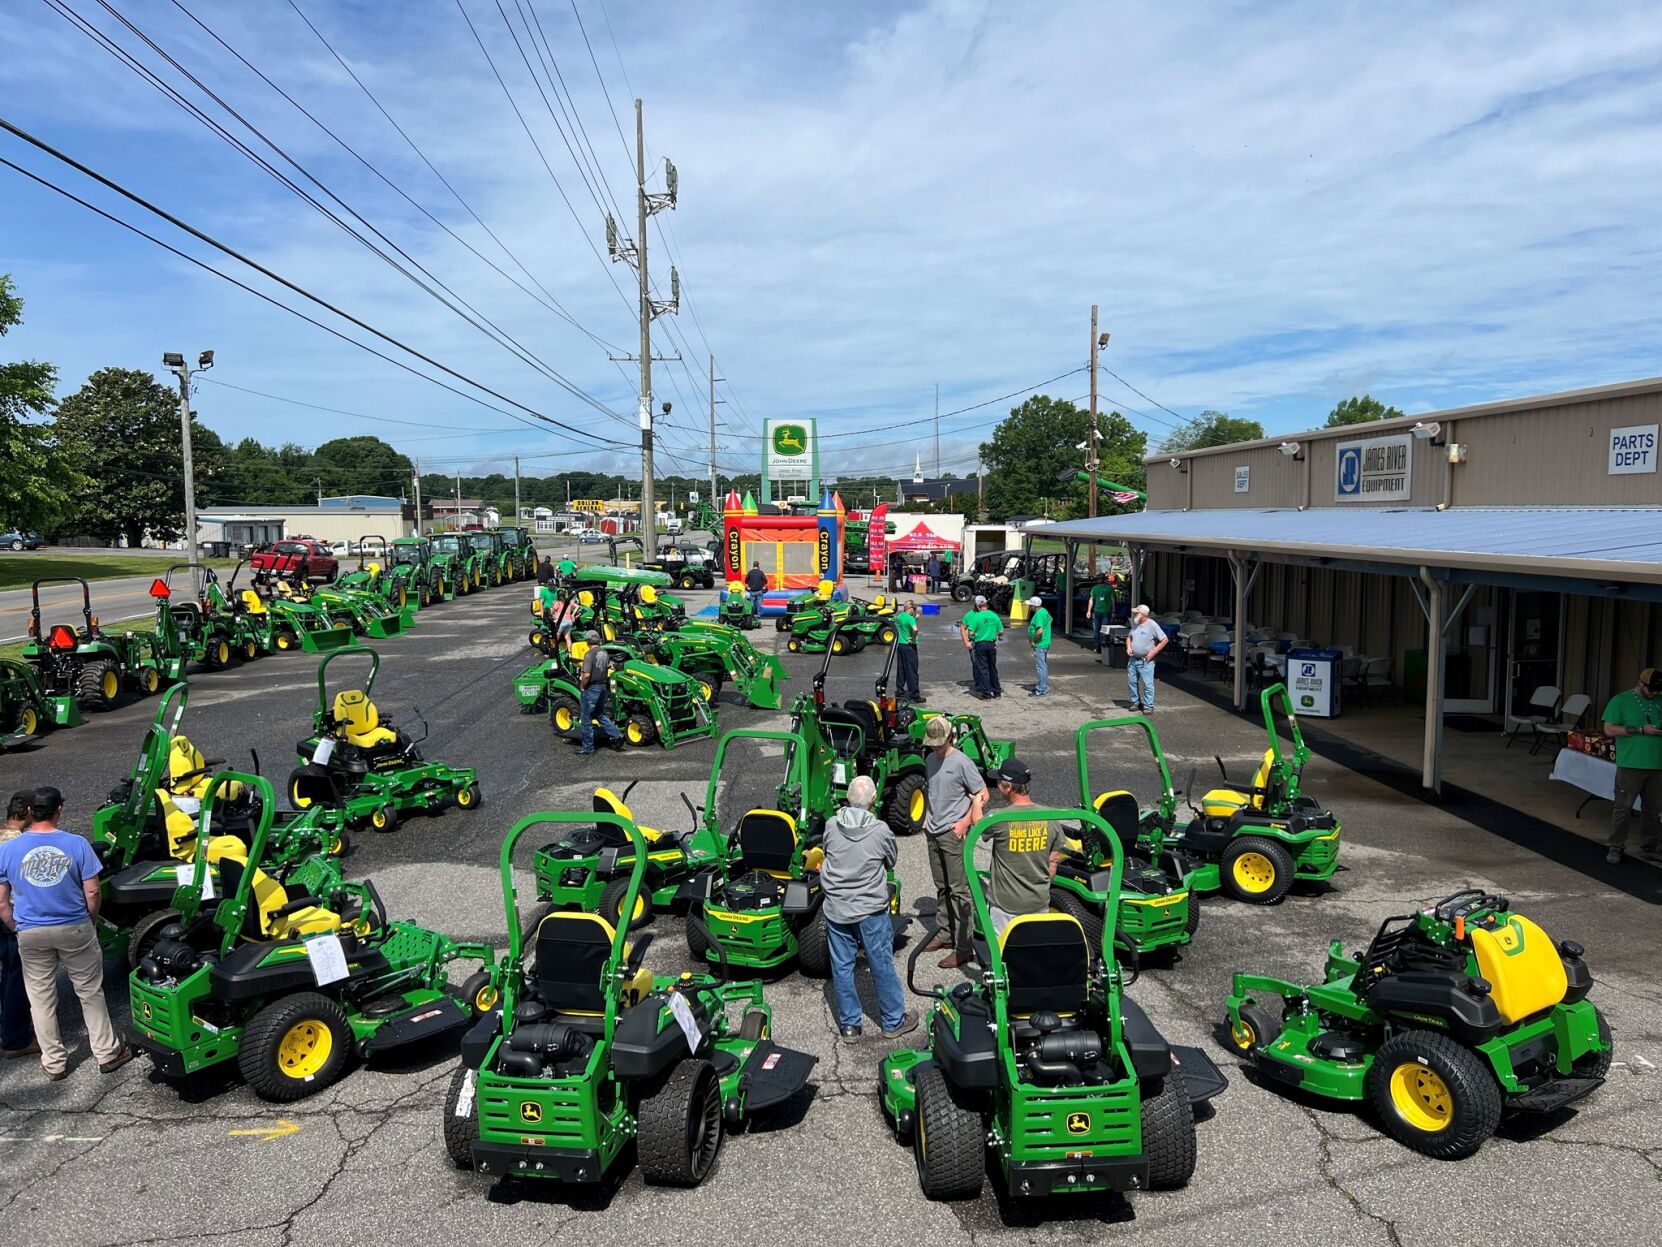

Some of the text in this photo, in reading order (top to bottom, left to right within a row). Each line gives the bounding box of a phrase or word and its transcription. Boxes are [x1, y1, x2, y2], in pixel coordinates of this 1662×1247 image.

[1612, 433, 1654, 450] PARTS
[1362, 444, 1407, 472] JAMES RIVER
[1615, 450, 1649, 467] DEPT
[1236, 470, 1249, 480] SALES
[1362, 477, 1405, 493] EQUIPMENT
[729, 531, 740, 570] Crayon
[819, 531, 830, 570] Crayon
[376, 758, 404, 769] JOHN DEERE
[1009, 827, 1048, 839] RUNS LIKE A
[1009, 836, 1048, 852] DEERE
